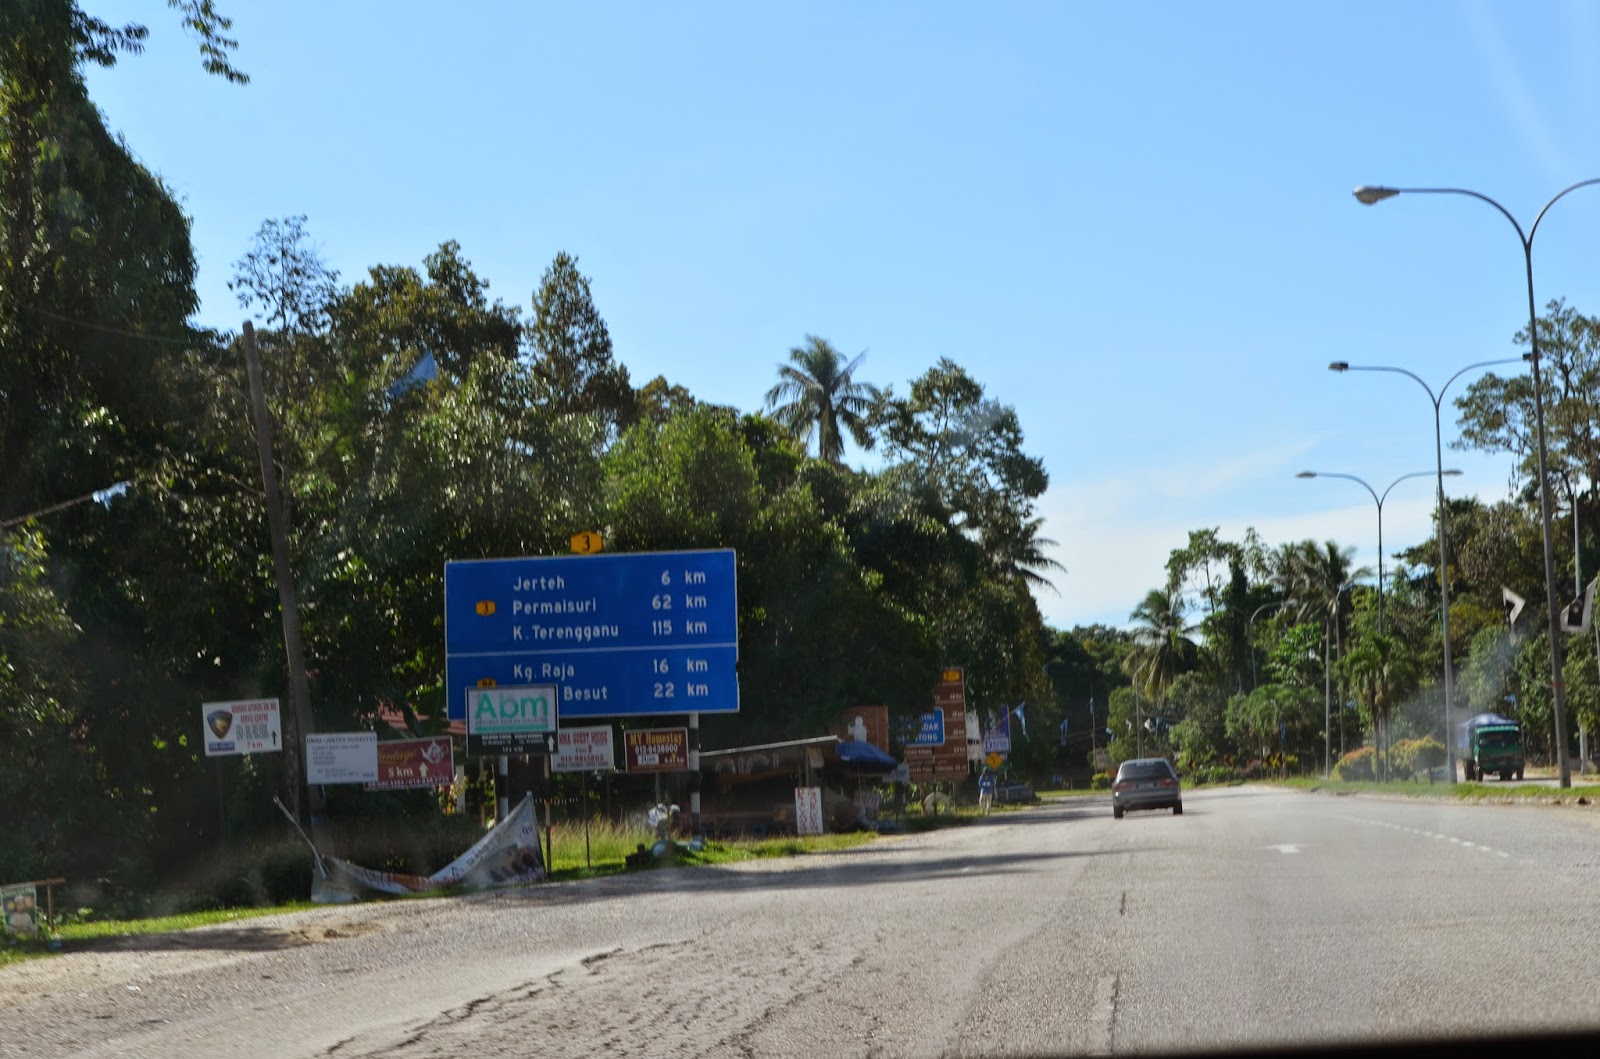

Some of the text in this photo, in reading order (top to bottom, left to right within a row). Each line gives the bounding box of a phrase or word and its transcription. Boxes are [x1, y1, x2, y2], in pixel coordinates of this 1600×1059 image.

[582, 535, 591, 551] 3
[513, 569, 706, 592] Jerteh 6 km
[513, 593, 707, 616] Permaisuri 62 km
[532, 624, 619, 642] Terengganu
[652, 619, 672, 635] 115
[686, 619, 707, 634] km
[513, 658, 708, 683] Kg. Raja 16 km
[564, 681, 708, 701] Besut 22 km
[475, 692, 549, 719] Abm
[573, 731, 590, 745] GUEST
[590, 730, 608, 745] HOUSE
[630, 732, 683, 746] MY Homestay
[388, 766, 413, 777] 5 km
